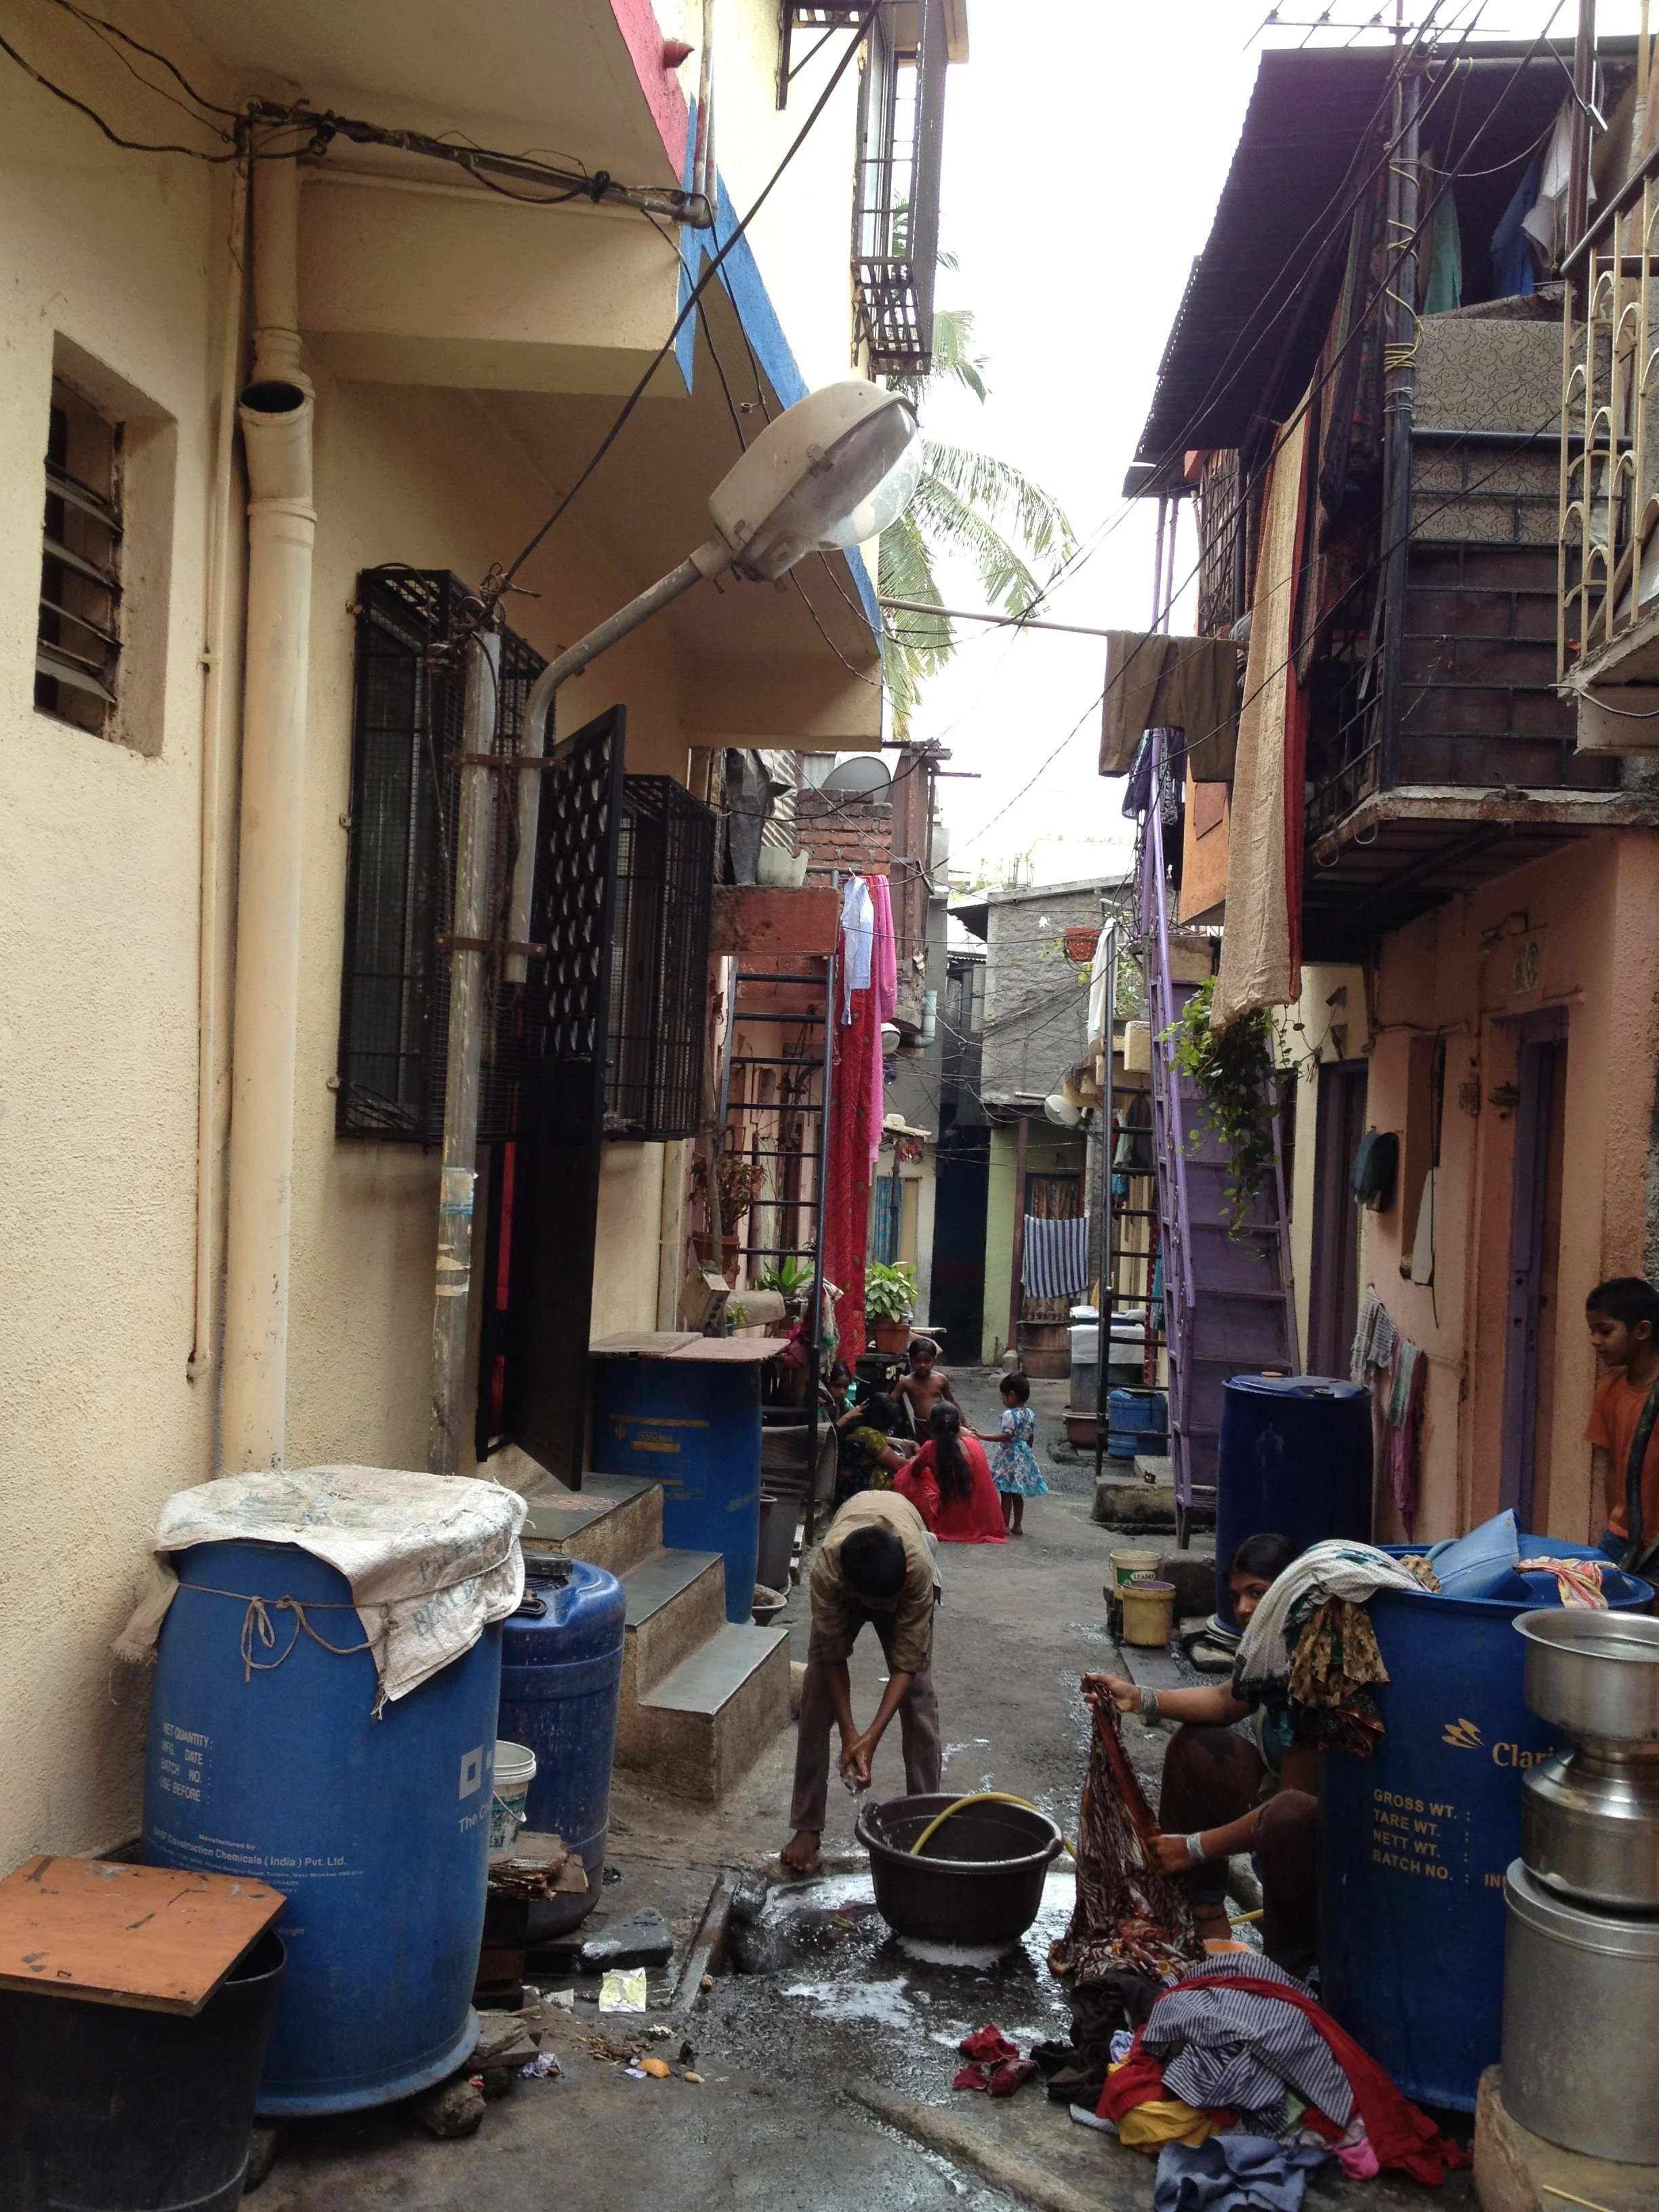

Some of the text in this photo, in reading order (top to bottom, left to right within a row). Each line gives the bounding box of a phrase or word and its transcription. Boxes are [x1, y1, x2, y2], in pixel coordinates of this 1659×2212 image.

[184, 1748, 204, 1765] DATE
[173, 1781, 201, 1802] BEFORE
[1373, 1788, 1424, 1814] GROSS
[1429, 1802, 1457, 1820] WT.
[457, 1814, 478, 1834] The
[1373, 1808, 1410, 1830] TARE
[1414, 1819, 1441, 1837] WT.
[169, 1834, 214, 1857] Construction
[215, 1848, 262, 1865] Chemicals
[327, 1856, 347, 1866] Ltd.
[1373, 1828, 1409, 1849] NETT
[1414, 1839, 1441, 1858] WT.
[1372, 1848, 1420, 1874] BATCH
[1425, 1863, 1453, 1881] NO.
